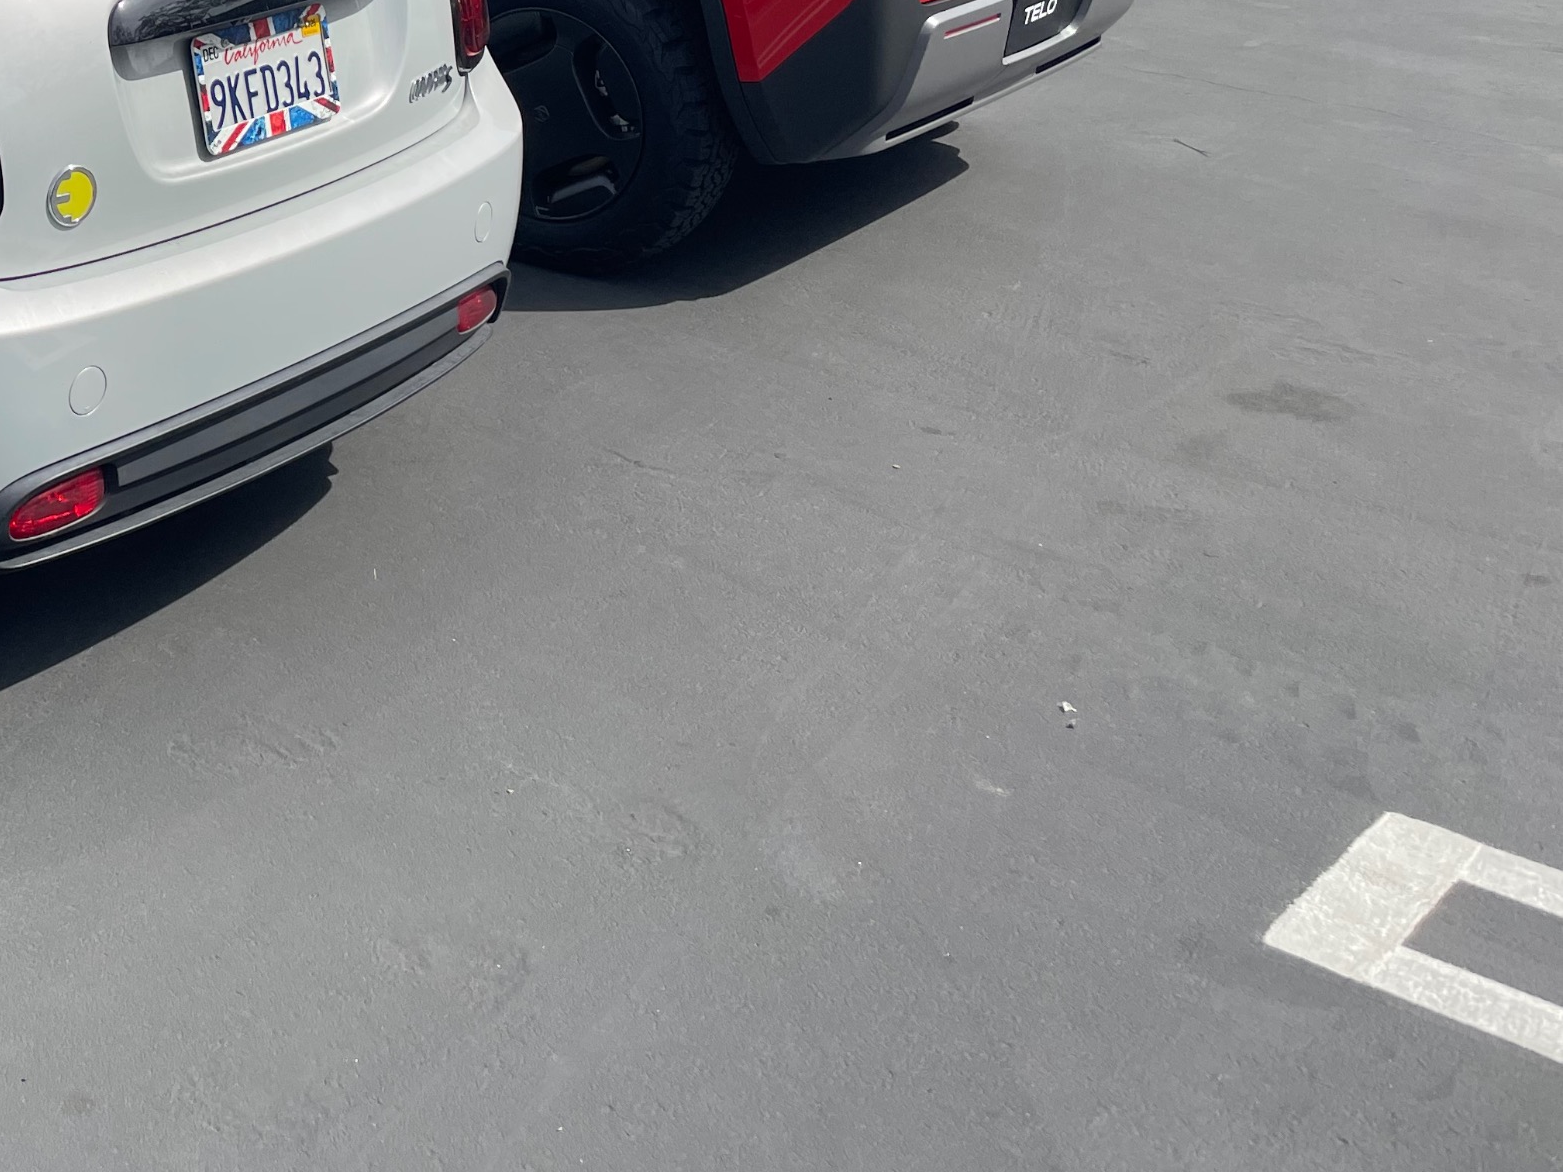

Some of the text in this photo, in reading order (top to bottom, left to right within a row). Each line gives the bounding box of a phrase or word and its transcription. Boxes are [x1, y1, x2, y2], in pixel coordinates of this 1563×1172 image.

[203, 46, 219, 63] DEC
[223, 32, 303, 66] California
[210, 50, 326, 130] 9KFD343
